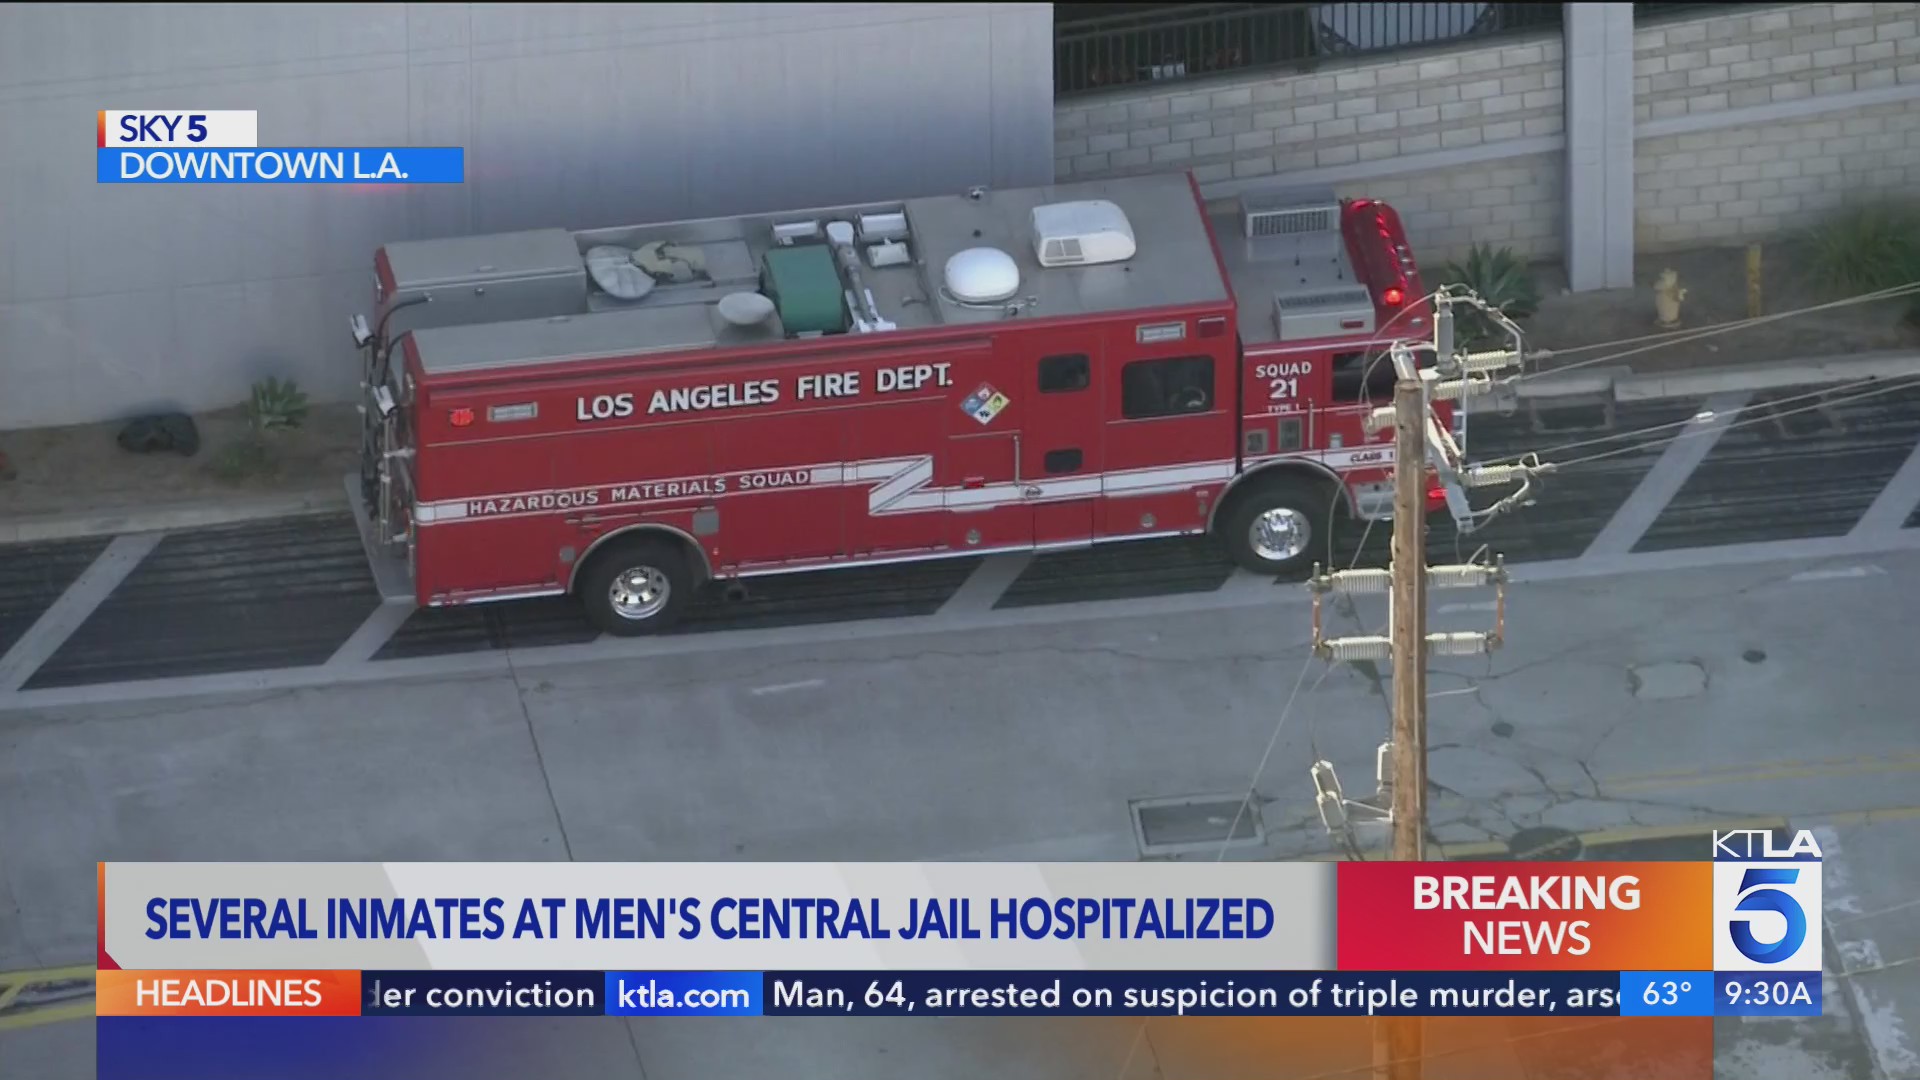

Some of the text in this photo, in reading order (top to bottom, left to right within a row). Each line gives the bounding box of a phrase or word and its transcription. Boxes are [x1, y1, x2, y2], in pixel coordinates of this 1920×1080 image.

[1256, 361, 1312, 378] SQUAD
[577, 362, 953, 421] LOS ANGELES FIRE DEPT.
[1270, 378, 1297, 399] 21
[468, 469, 810, 516] HAZARDOUS MATERIALS SQUAD
